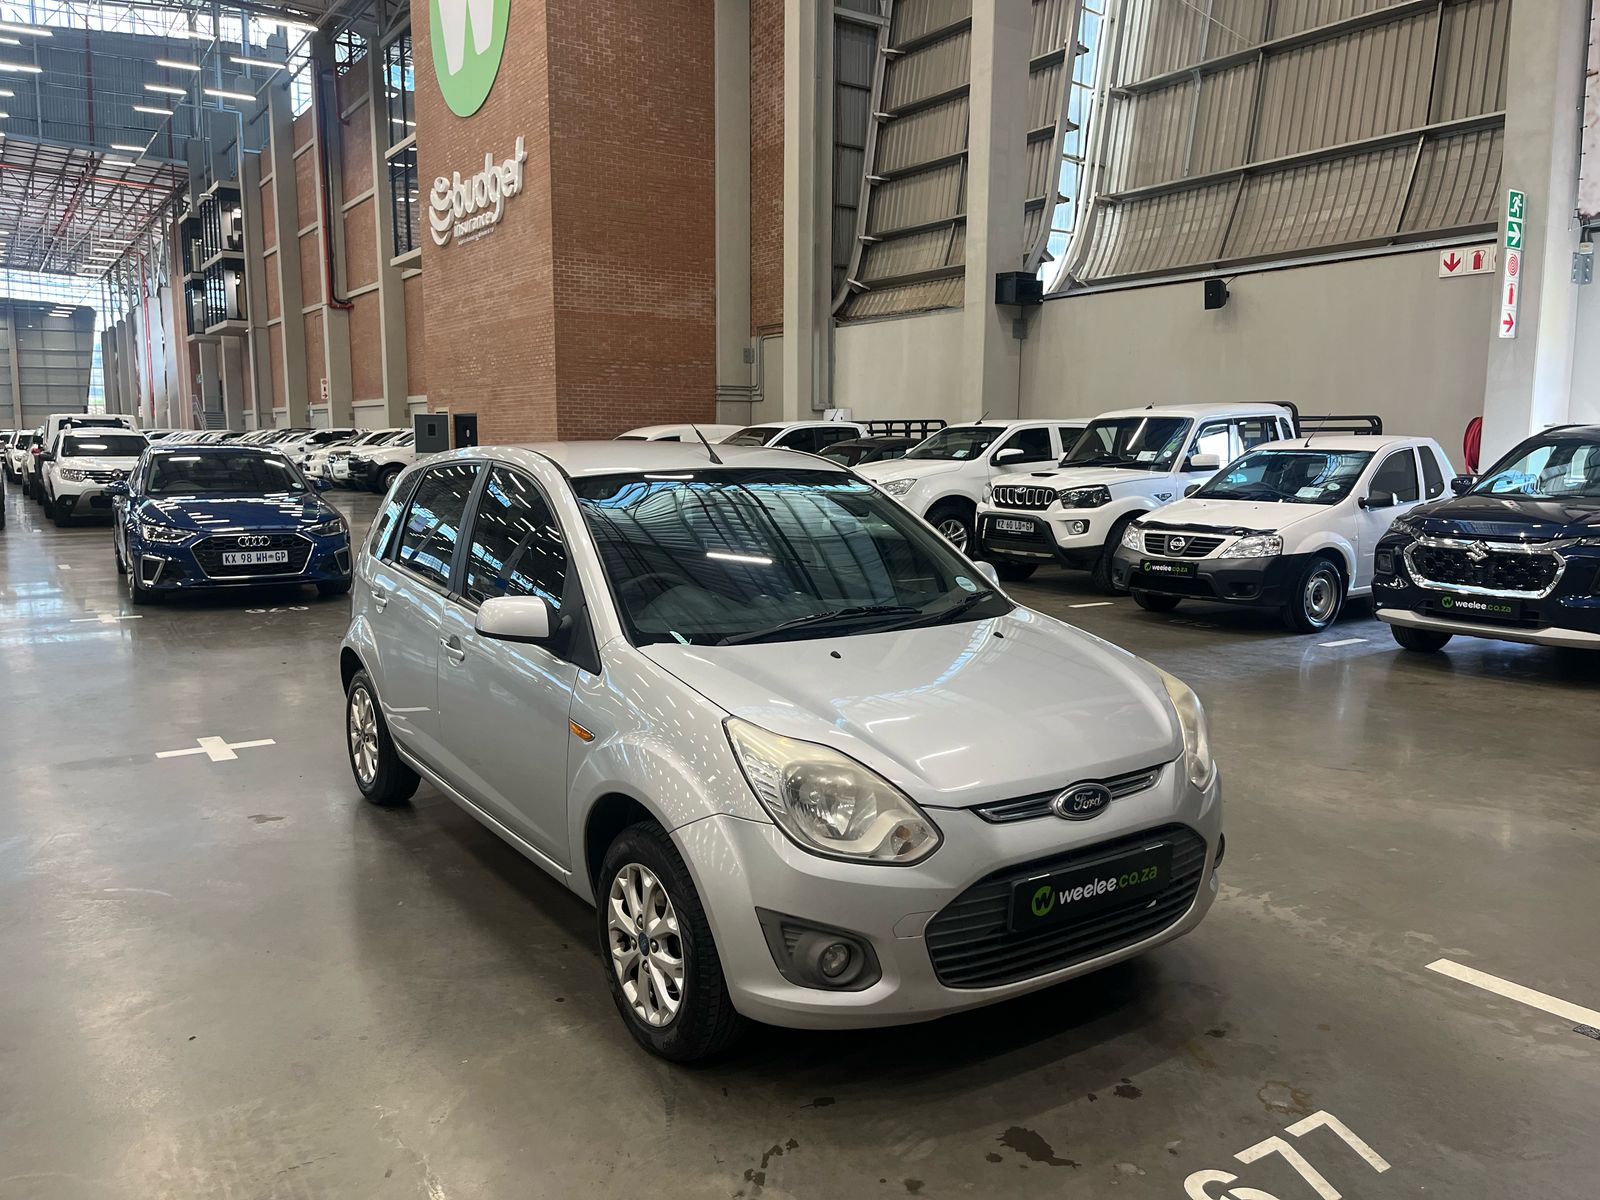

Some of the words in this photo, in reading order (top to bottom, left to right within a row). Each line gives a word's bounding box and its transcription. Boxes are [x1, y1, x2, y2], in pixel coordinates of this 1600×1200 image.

[453, 136, 527, 223] budget
[225, 553, 237, 564] KX
[240, 553, 252, 563] 98
[256, 552, 268, 562] WH
[275, 551, 286, 561] GP
[1455, 600, 1512, 613] weelee.co.za
[1073, 791, 1101, 811] Ford
[1059, 865, 1158, 905] weelee.co.za
